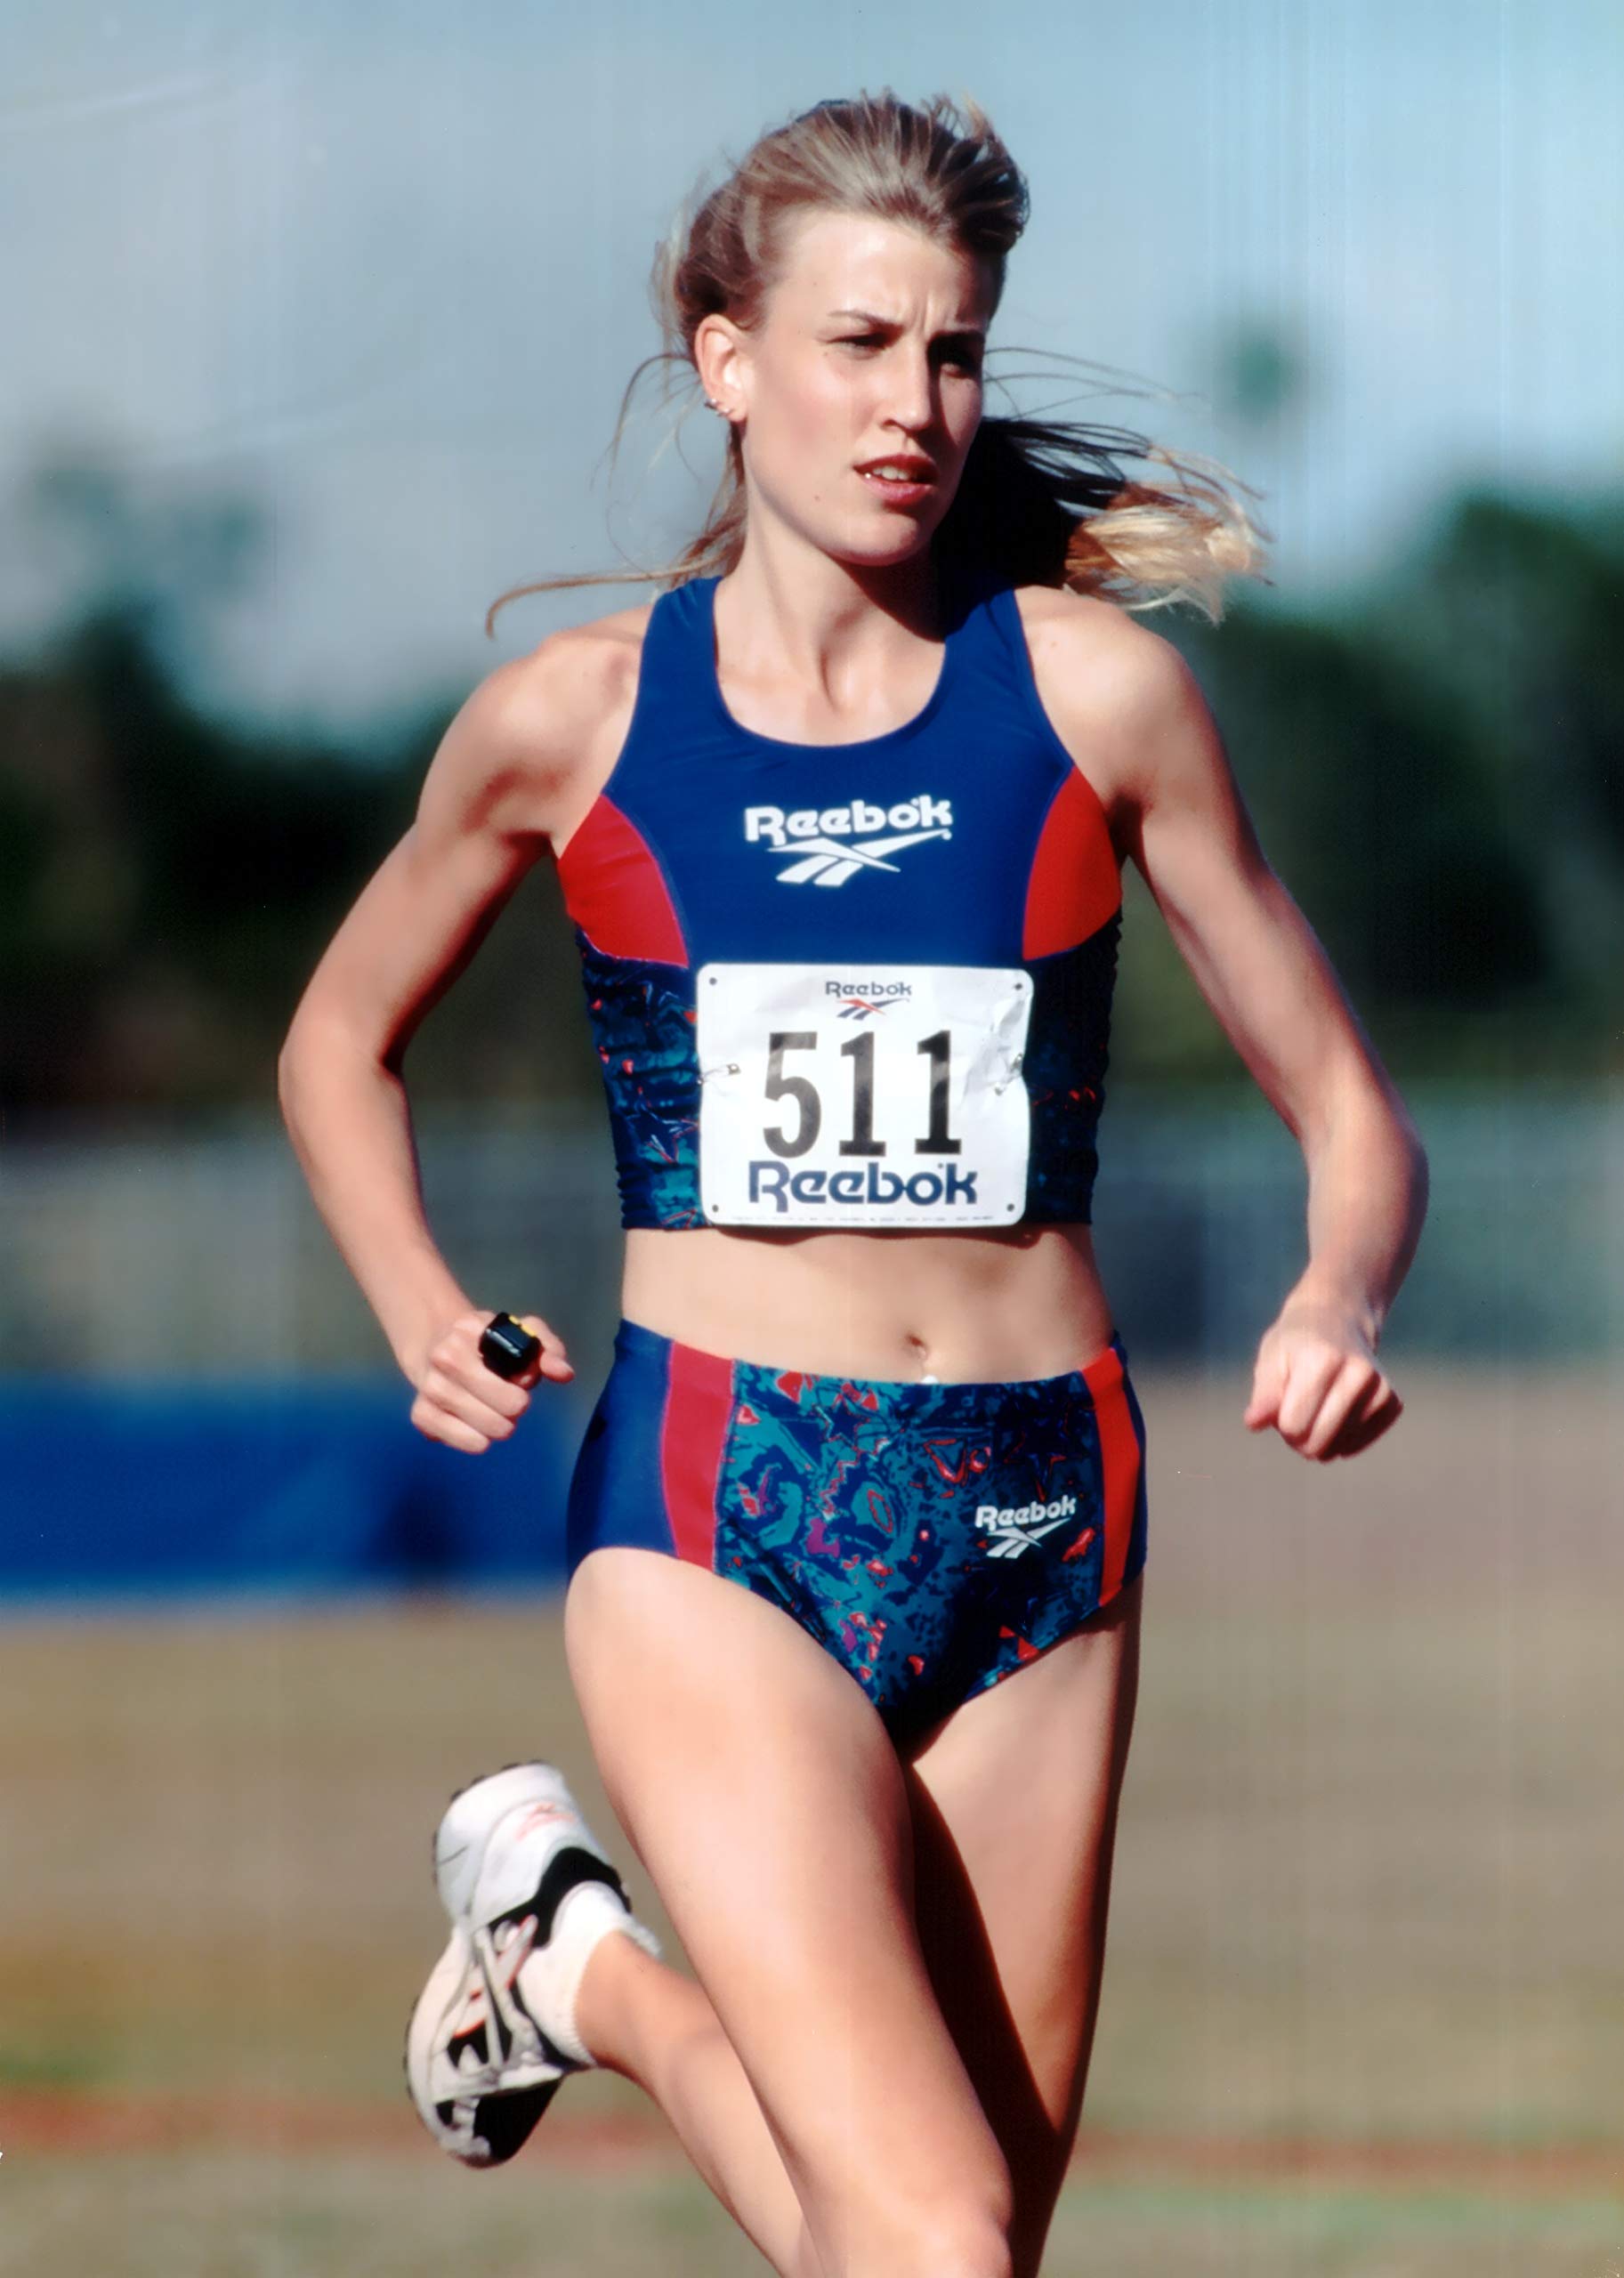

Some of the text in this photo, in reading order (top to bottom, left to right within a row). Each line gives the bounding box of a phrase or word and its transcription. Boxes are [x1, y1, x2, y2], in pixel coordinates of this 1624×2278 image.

[744, 795, 953, 846] Reebok
[826, 981, 913, 998] Reebok
[763, 1030, 962, 1159] 511
[748, 1160, 978, 1213] Reebok
[974, 1495, 1077, 1531] Reebok
